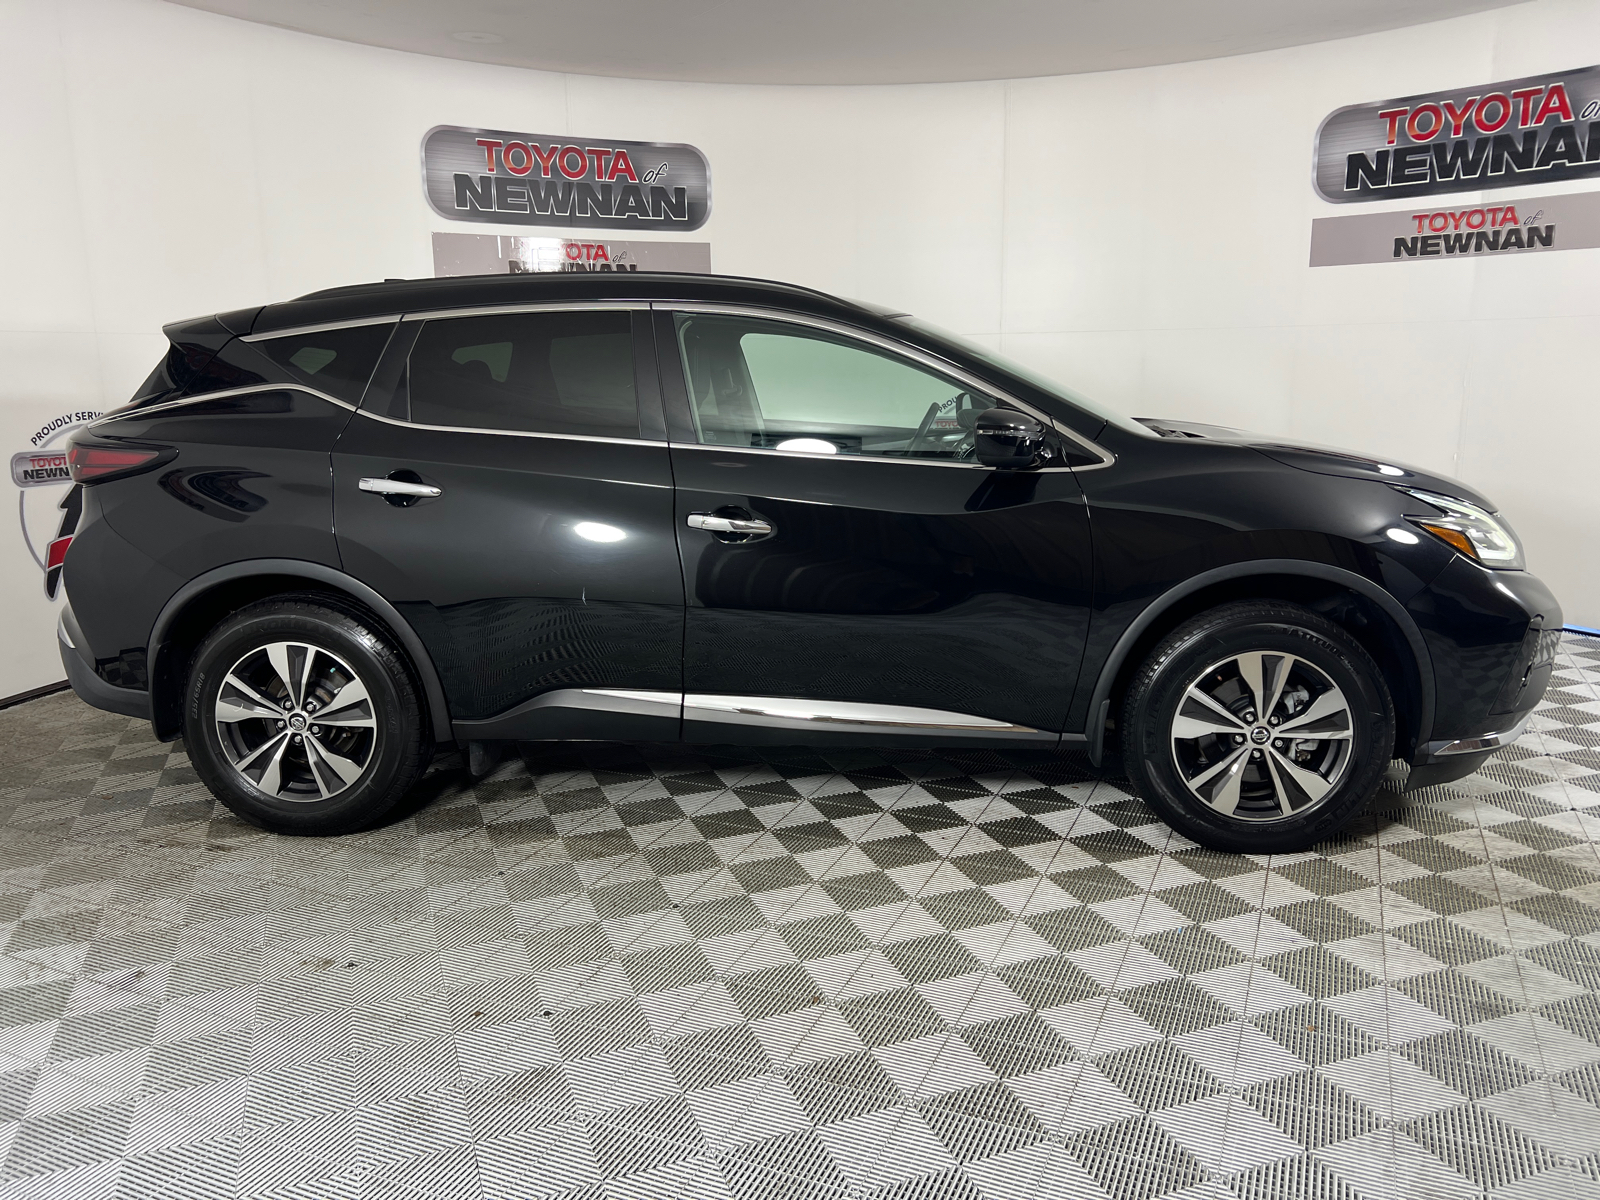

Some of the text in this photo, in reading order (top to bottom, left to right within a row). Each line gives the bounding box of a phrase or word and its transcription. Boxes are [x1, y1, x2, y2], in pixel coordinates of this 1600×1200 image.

[1378, 82, 1575, 146] TOYOTA
[475, 138, 669, 184] TOYOTA of
[453, 173, 688, 220] NEWNAN
[1412, 205, 1544, 234] TOYOTA of
[1393, 223, 1556, 259] NEWNAN
[938, 396, 957, 413] PROU
[30, 411, 103, 446] PROUDLY SERV
[23, 466, 70, 480] NEWN
[29, 456, 67, 469] TOYOT
